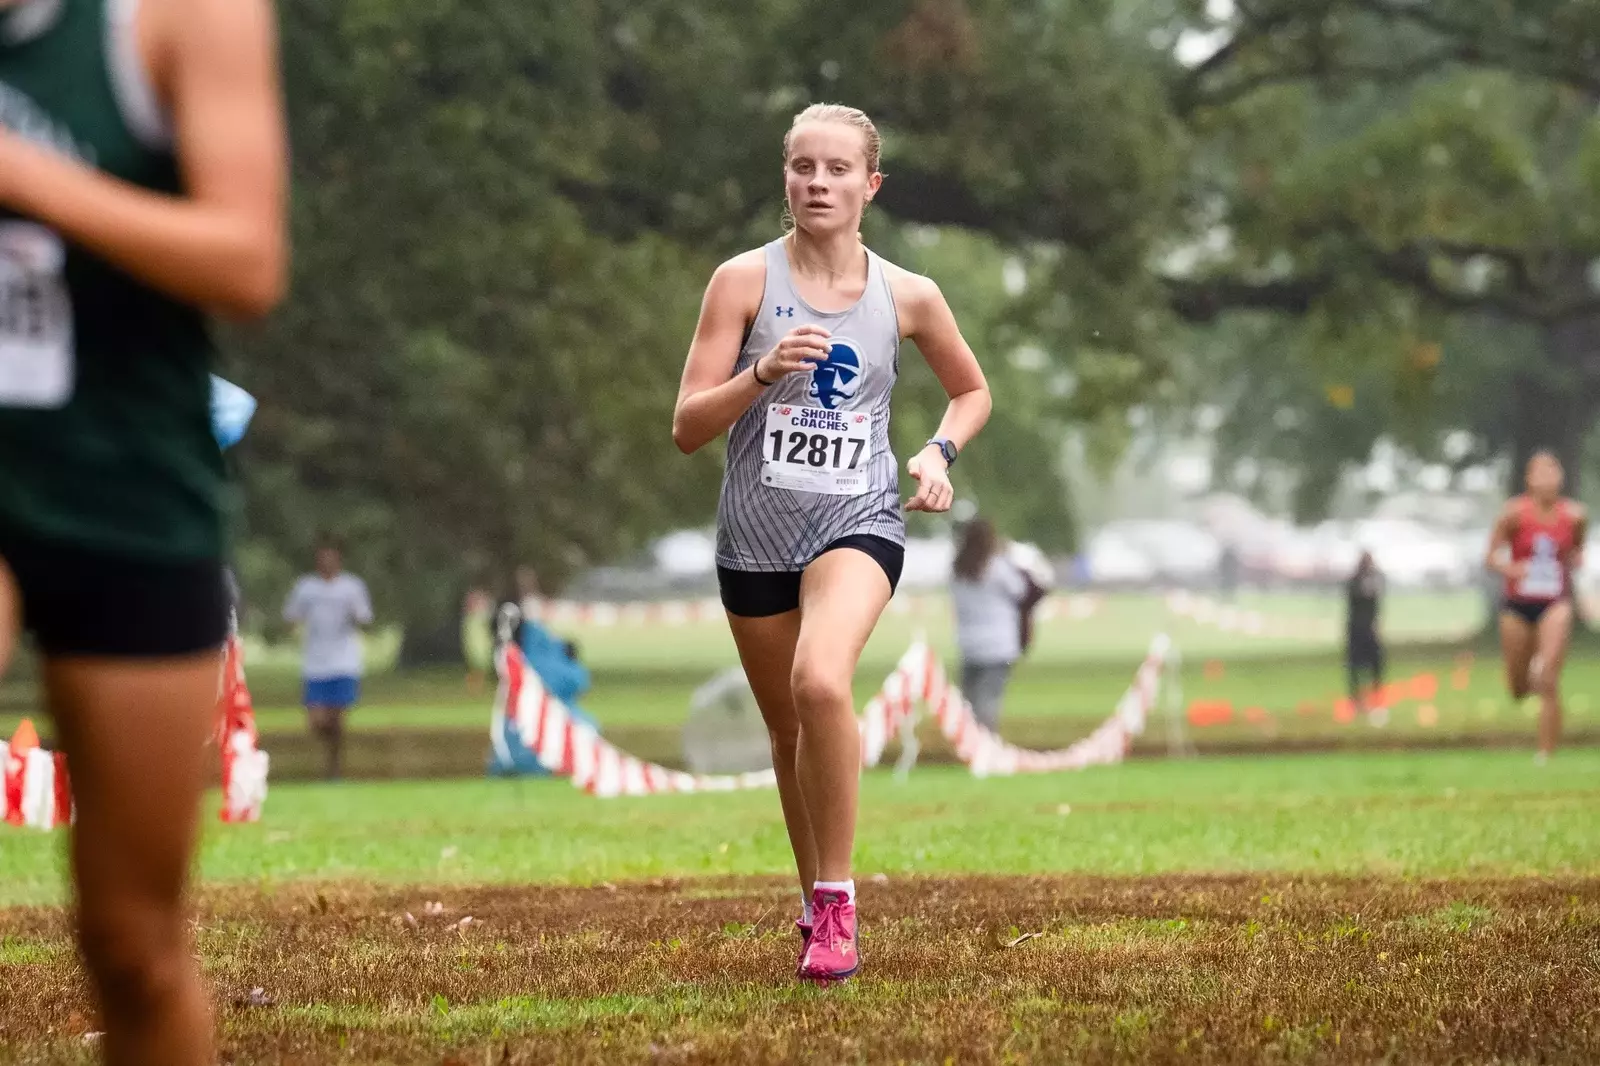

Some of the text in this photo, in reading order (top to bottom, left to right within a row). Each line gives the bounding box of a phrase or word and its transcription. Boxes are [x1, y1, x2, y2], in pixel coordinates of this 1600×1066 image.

[801, 408, 842, 421] SHORE
[791, 417, 848, 431] COACHES
[770, 430, 865, 469] 12817
